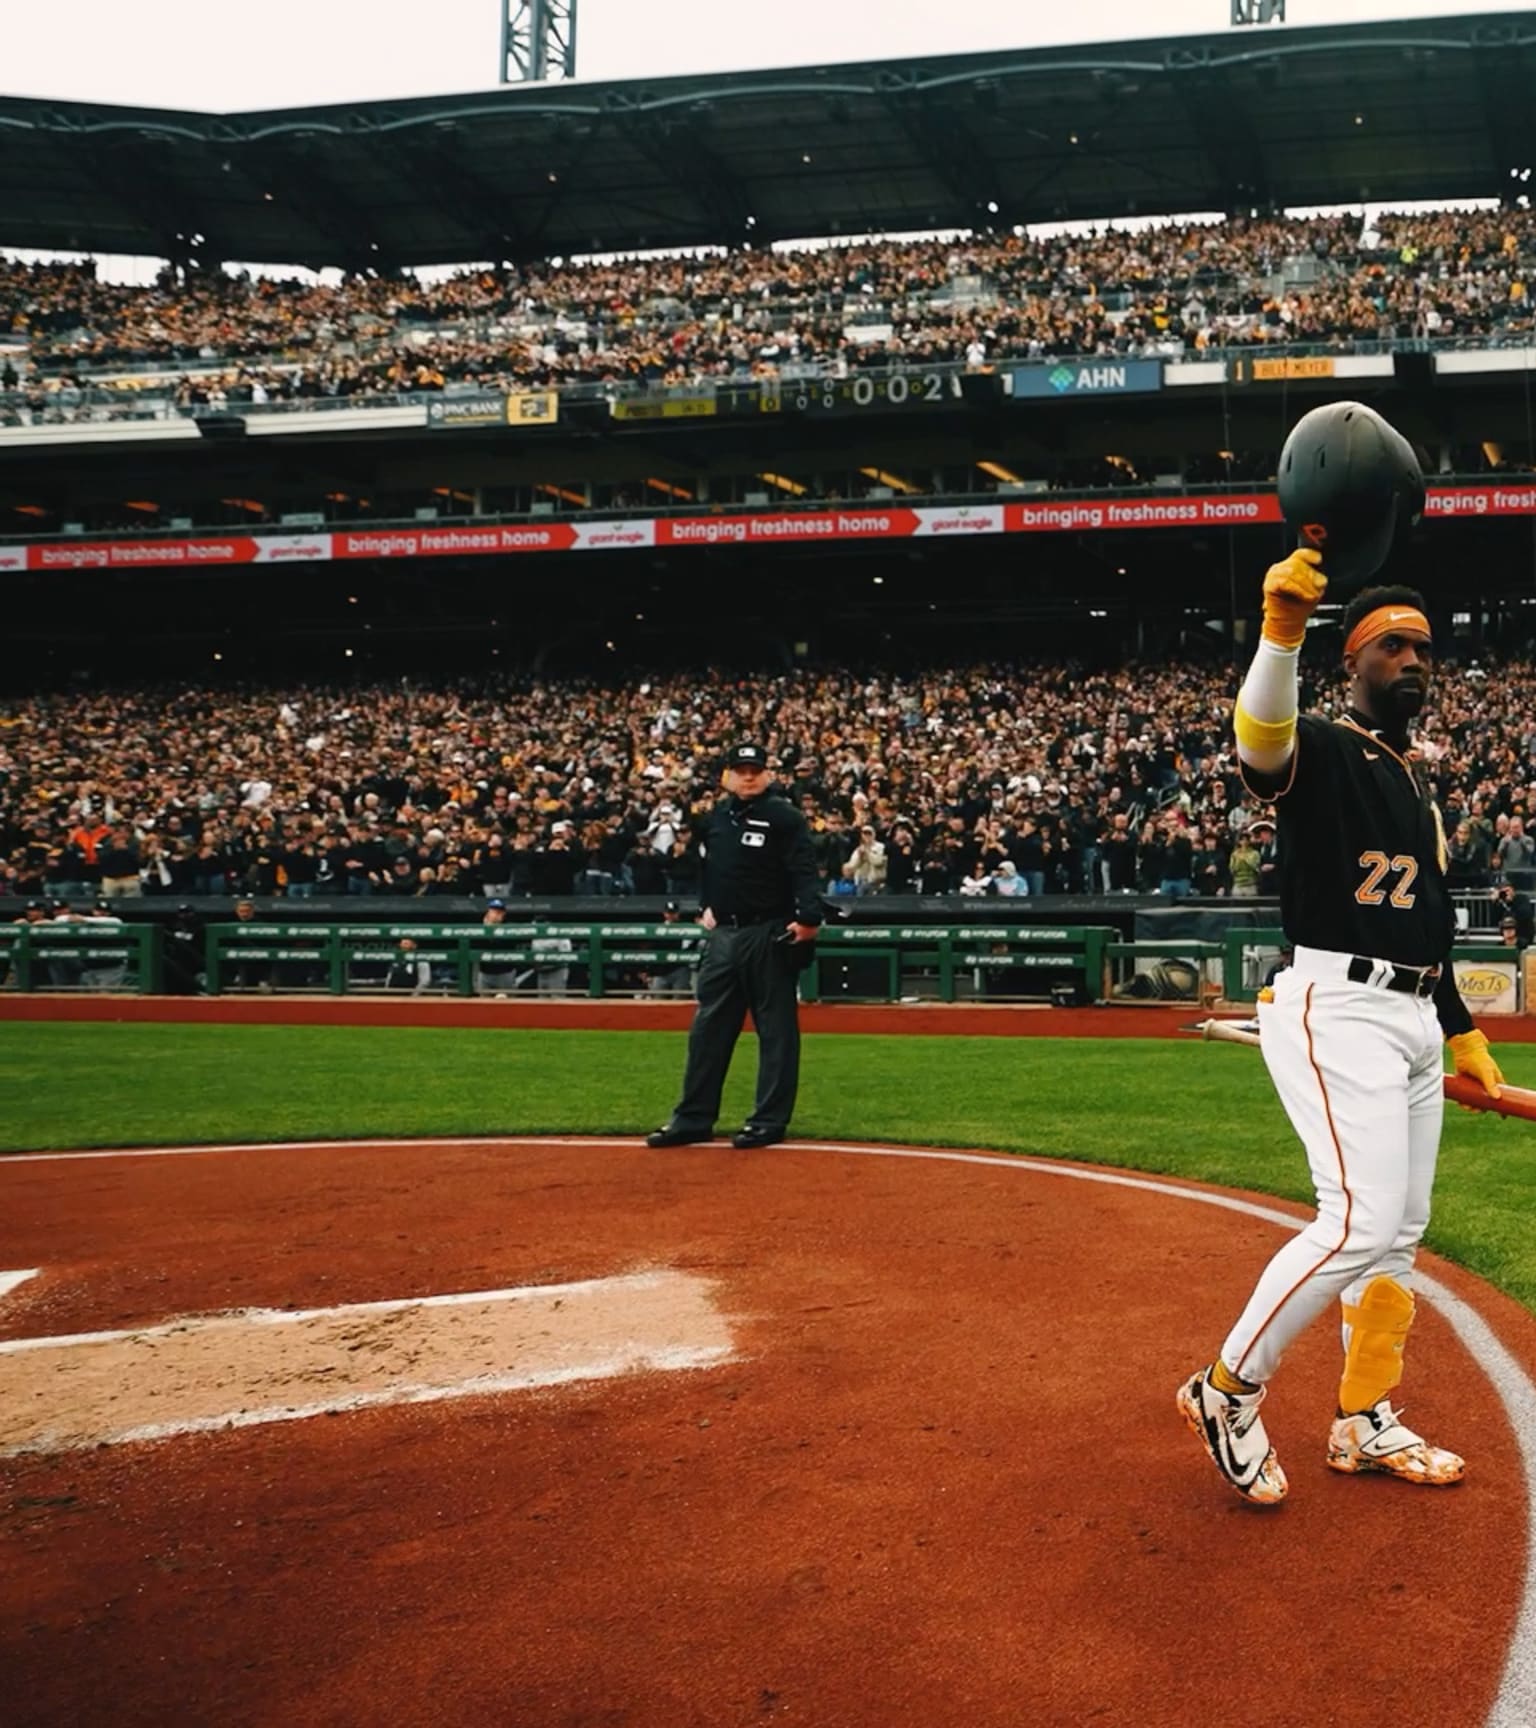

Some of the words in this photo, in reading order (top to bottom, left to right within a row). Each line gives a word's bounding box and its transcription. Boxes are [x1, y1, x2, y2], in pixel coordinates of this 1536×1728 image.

[1077, 366, 1126, 389] AHN
[1235, 360, 1243, 381] 1
[853, 377, 874, 406] 0
[887, 375, 909, 403] 0
[923, 373, 943, 401] 2
[1023, 505, 1103, 528] bringing
[1108, 502, 1198, 521] freshness
[1202, 500, 1259, 518] home
[1425, 490, 1488, 513] inging
[672, 520, 747, 542] bringing
[751, 517, 833, 536] freshness
[838, 515, 891, 532] home
[42, 548, 109, 567] bringing
[187, 543, 234, 559] home
[348, 536, 417, 555] bringing
[421, 532, 498, 549] freshness
[502, 529, 550, 546] home
[1354, 850, 1419, 910] 22
